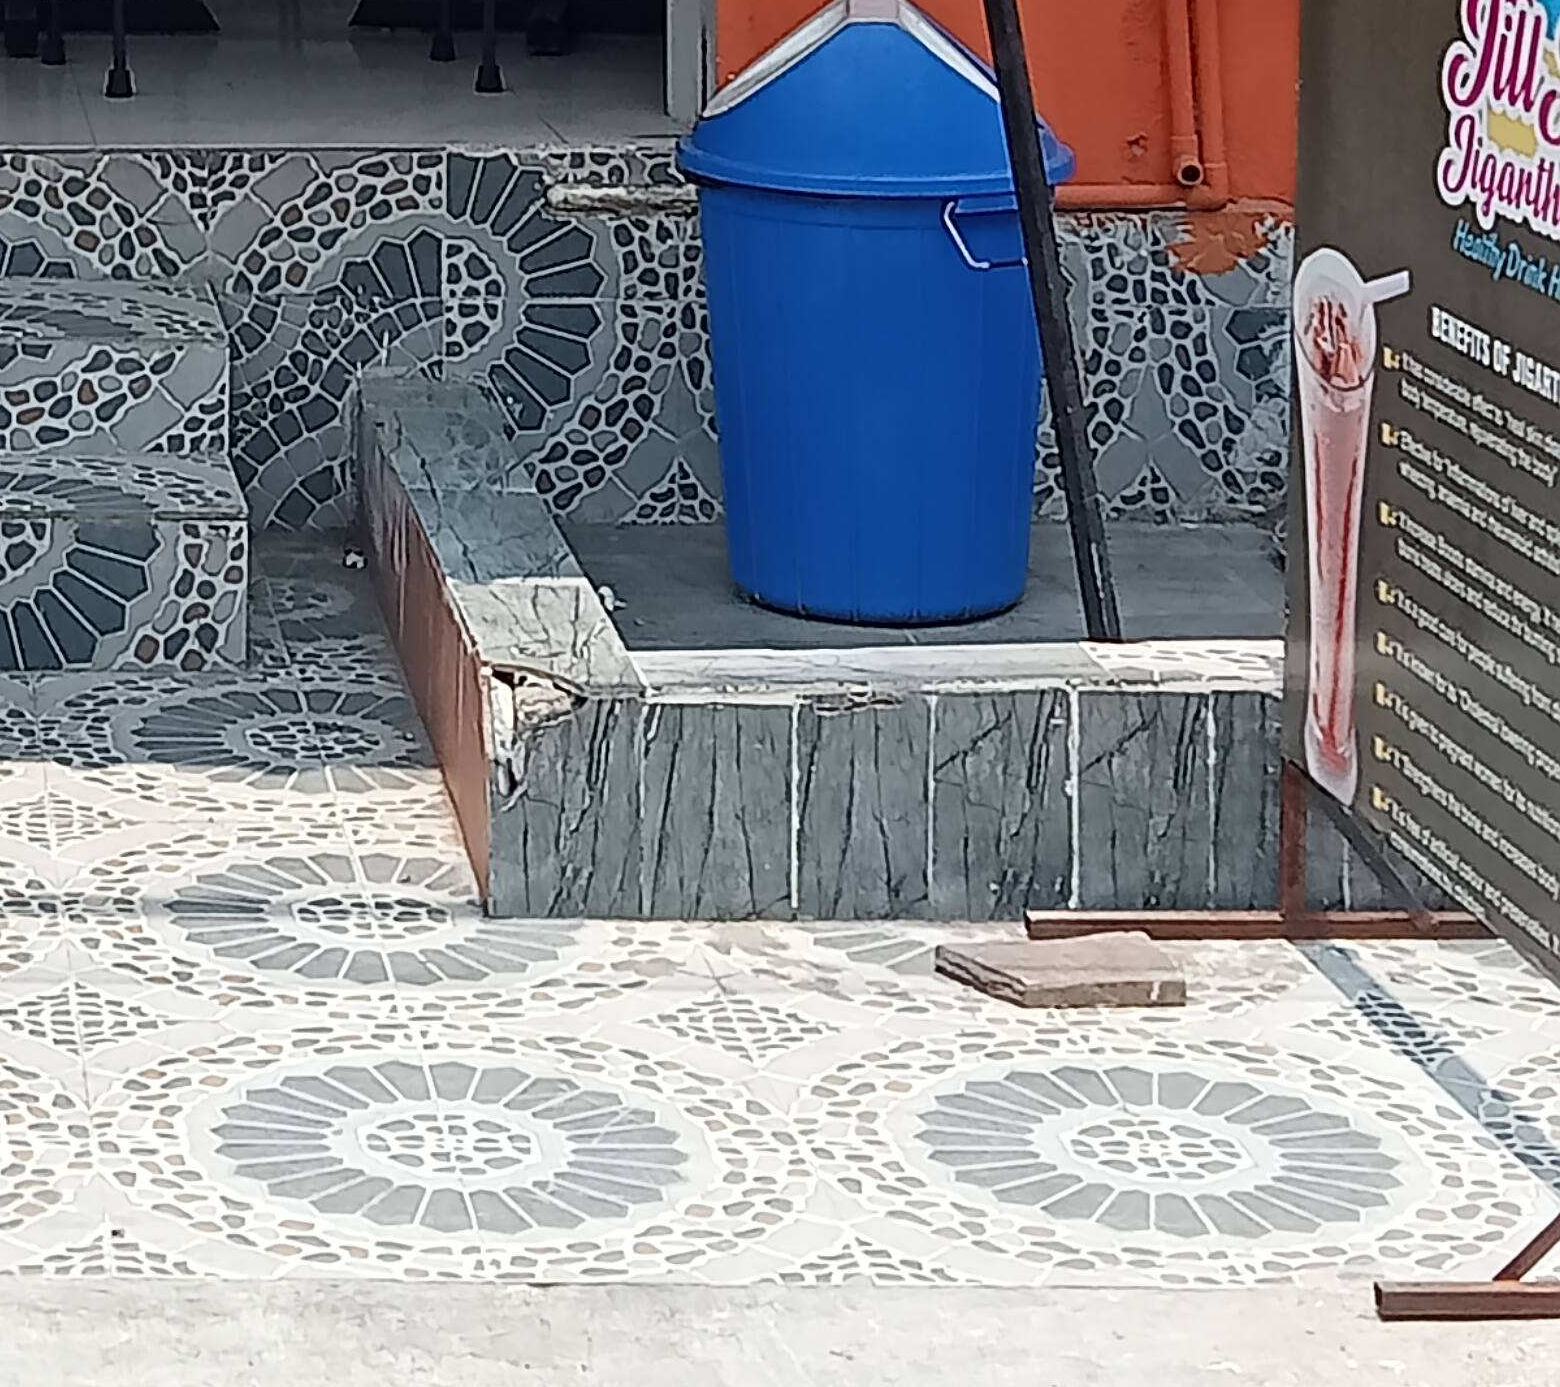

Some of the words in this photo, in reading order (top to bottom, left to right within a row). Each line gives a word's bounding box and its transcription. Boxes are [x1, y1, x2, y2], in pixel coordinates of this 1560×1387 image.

[1506, 242, 1547, 293] Drink
[1431, 306, 1491, 366] BENEFITS
[1493, 340, 1511, 376] OF
